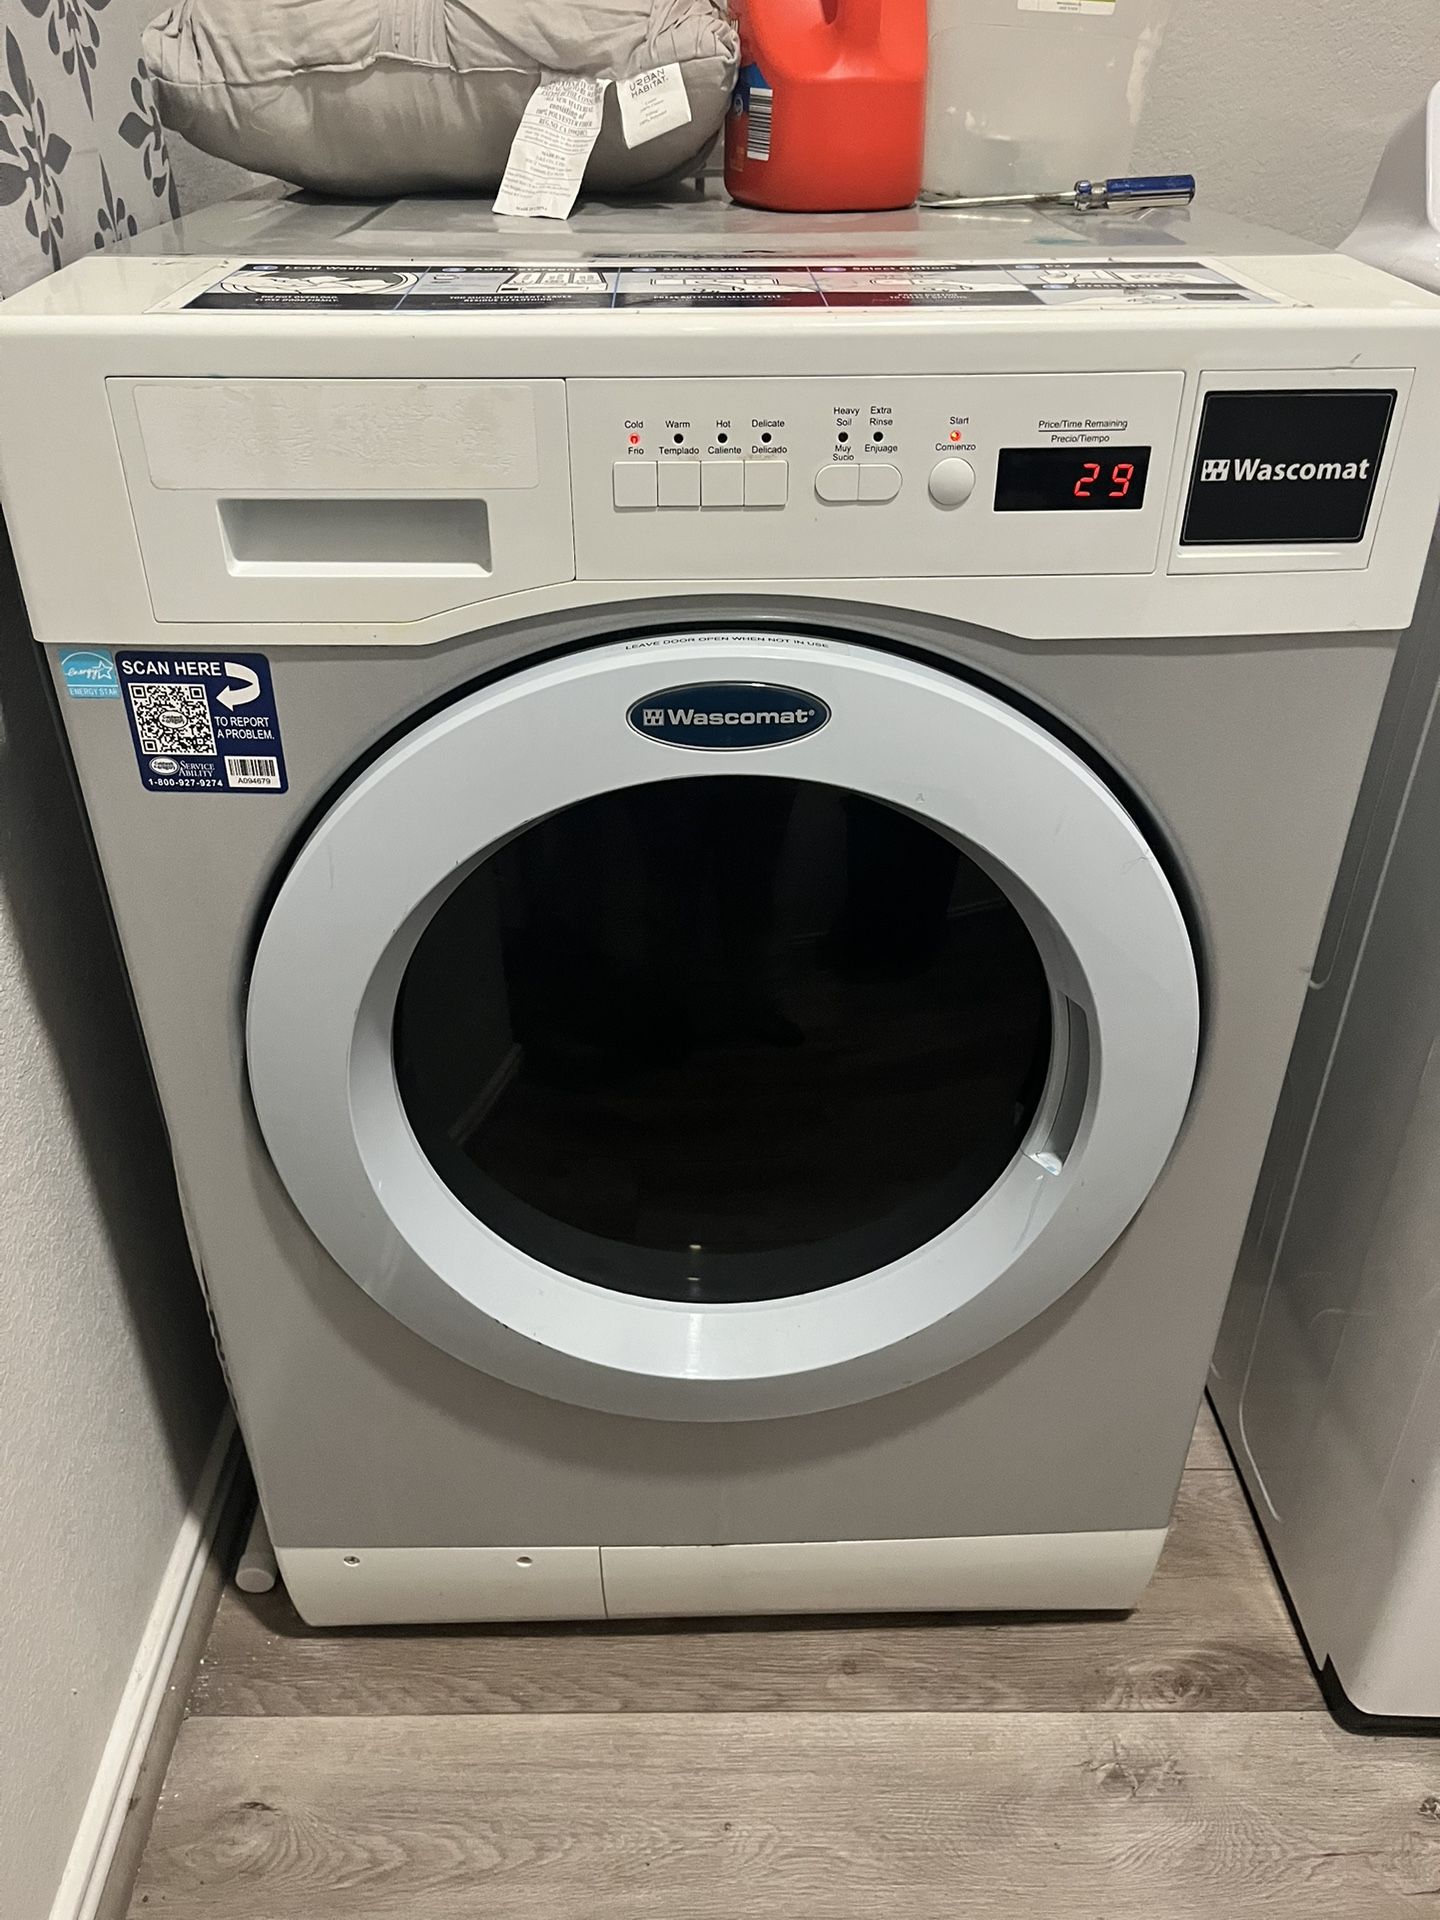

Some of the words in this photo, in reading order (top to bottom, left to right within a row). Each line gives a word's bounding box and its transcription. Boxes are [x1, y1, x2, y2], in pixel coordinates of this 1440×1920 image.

[629, 68, 665, 91] URBAN
[833, 407, 860, 416] Heavy
[870, 406, 892, 415] Extra
[624, 420, 644, 429] Cold
[665, 420, 691, 429] Warm
[716, 420, 731, 428] Hot
[751, 419, 785, 428] Delicate
[836, 418, 852, 426] Soil
[869, 418, 893, 426] Rinse
[950, 416, 969, 425] Start
[1038, 420, 1083, 429] Price/Time
[1084, 419, 1128, 430] Remaining
[1051, 434, 1110, 443] Precio/Tiempo
[658, 446, 700, 455] Templado
[707, 446, 742, 455] Caliente
[751, 446, 788, 454] Delicado
[834, 444, 852, 453] Muy
[864, 443, 898, 453] Enjuage
[935, 443, 977, 451] Comienzo
[832, 453, 855, 461] Sucio
[1234, 458, 1370, 481] Wascomat
[1074, 463, 1135, 497] 29
[625, 640, 660, 650] LEAVE
[663, 637, 696, 645] DOOR
[807, 641, 830, 649] USE
[121, 660, 170, 676] SCAN
[174, 661, 222, 677] HERE
[70, 687, 98, 696] ENERGY
[99, 688, 118, 696] STAR
[214, 716, 228, 727] TO
[230, 716, 270, 728] REPORT
[217, 728, 225, 739] A
[226, 728, 275, 740] PROBLEM.
[179, 760, 215, 770] SERVICE
[178, 768, 214, 777] ABILITY
[148, 778, 223, 787] 1-800-927-9274
